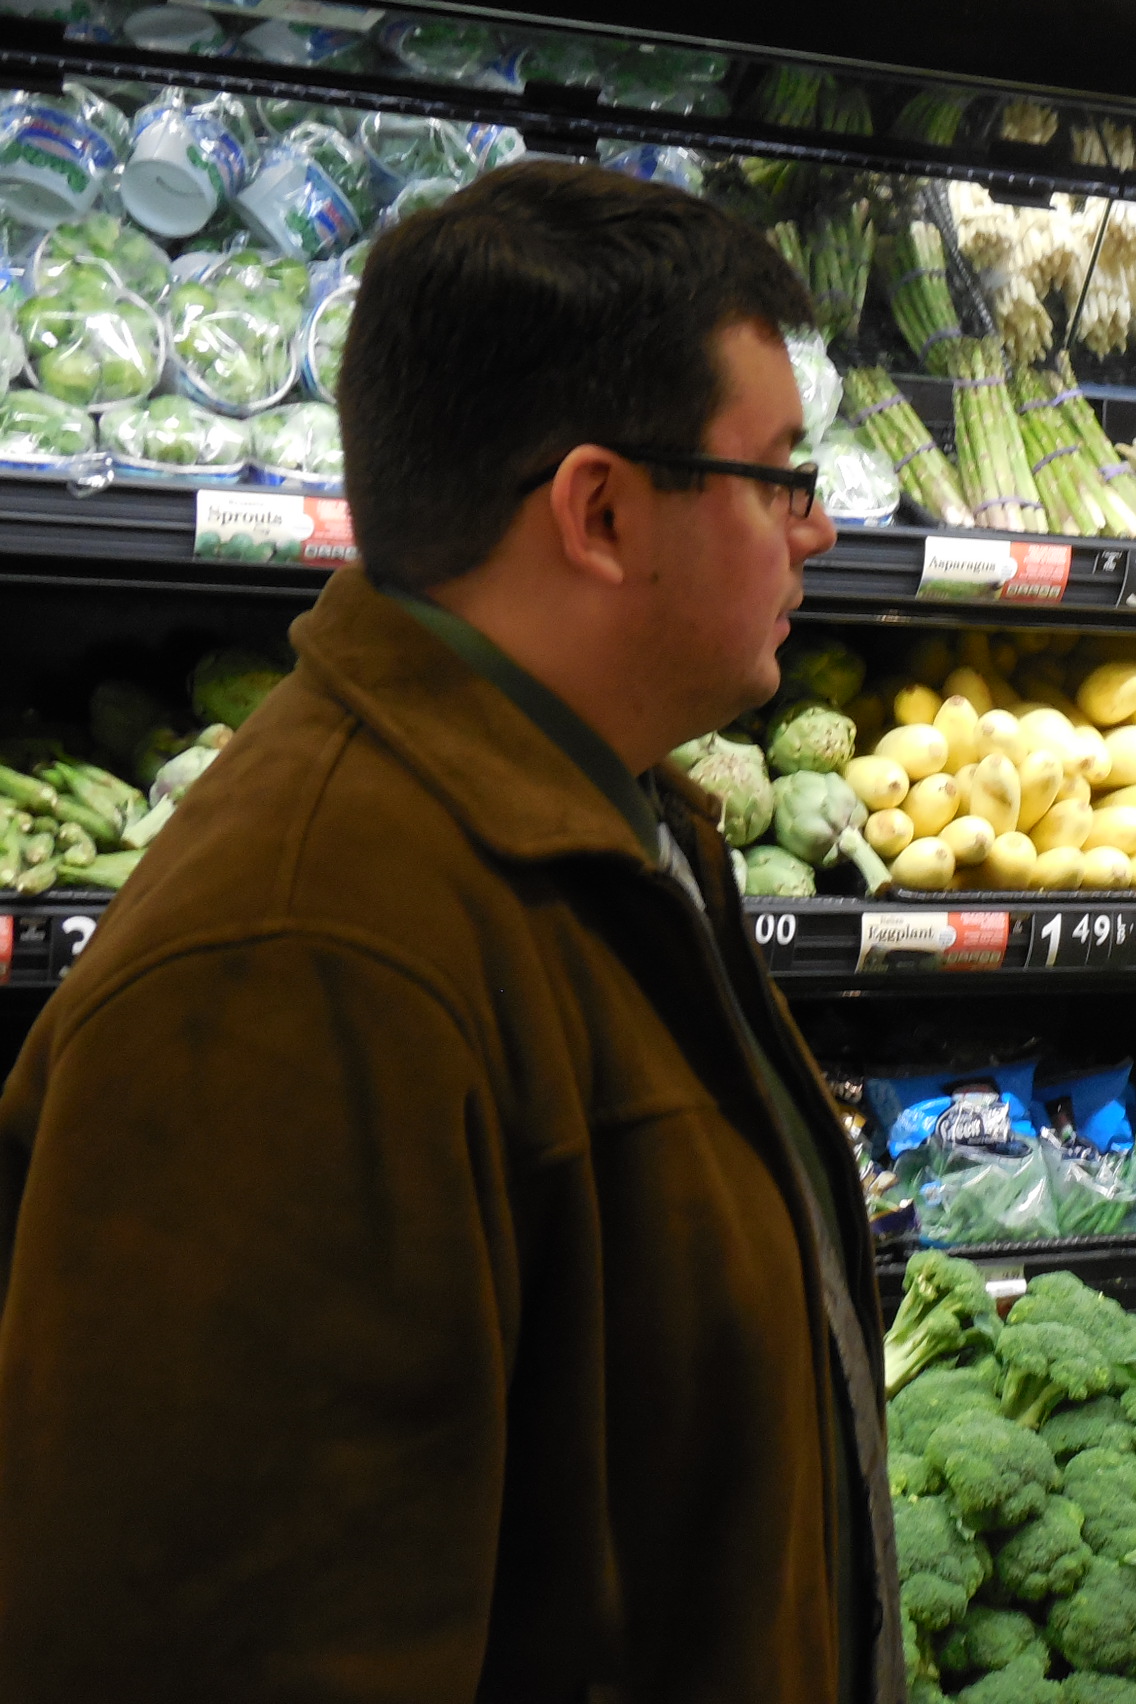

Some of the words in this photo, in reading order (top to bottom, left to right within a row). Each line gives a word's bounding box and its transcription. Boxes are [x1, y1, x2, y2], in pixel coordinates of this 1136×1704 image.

[208, 505, 283, 526] Sprouts
[929, 556, 996, 574] Asparagus
[868, 923, 934, 942] Eggplant
